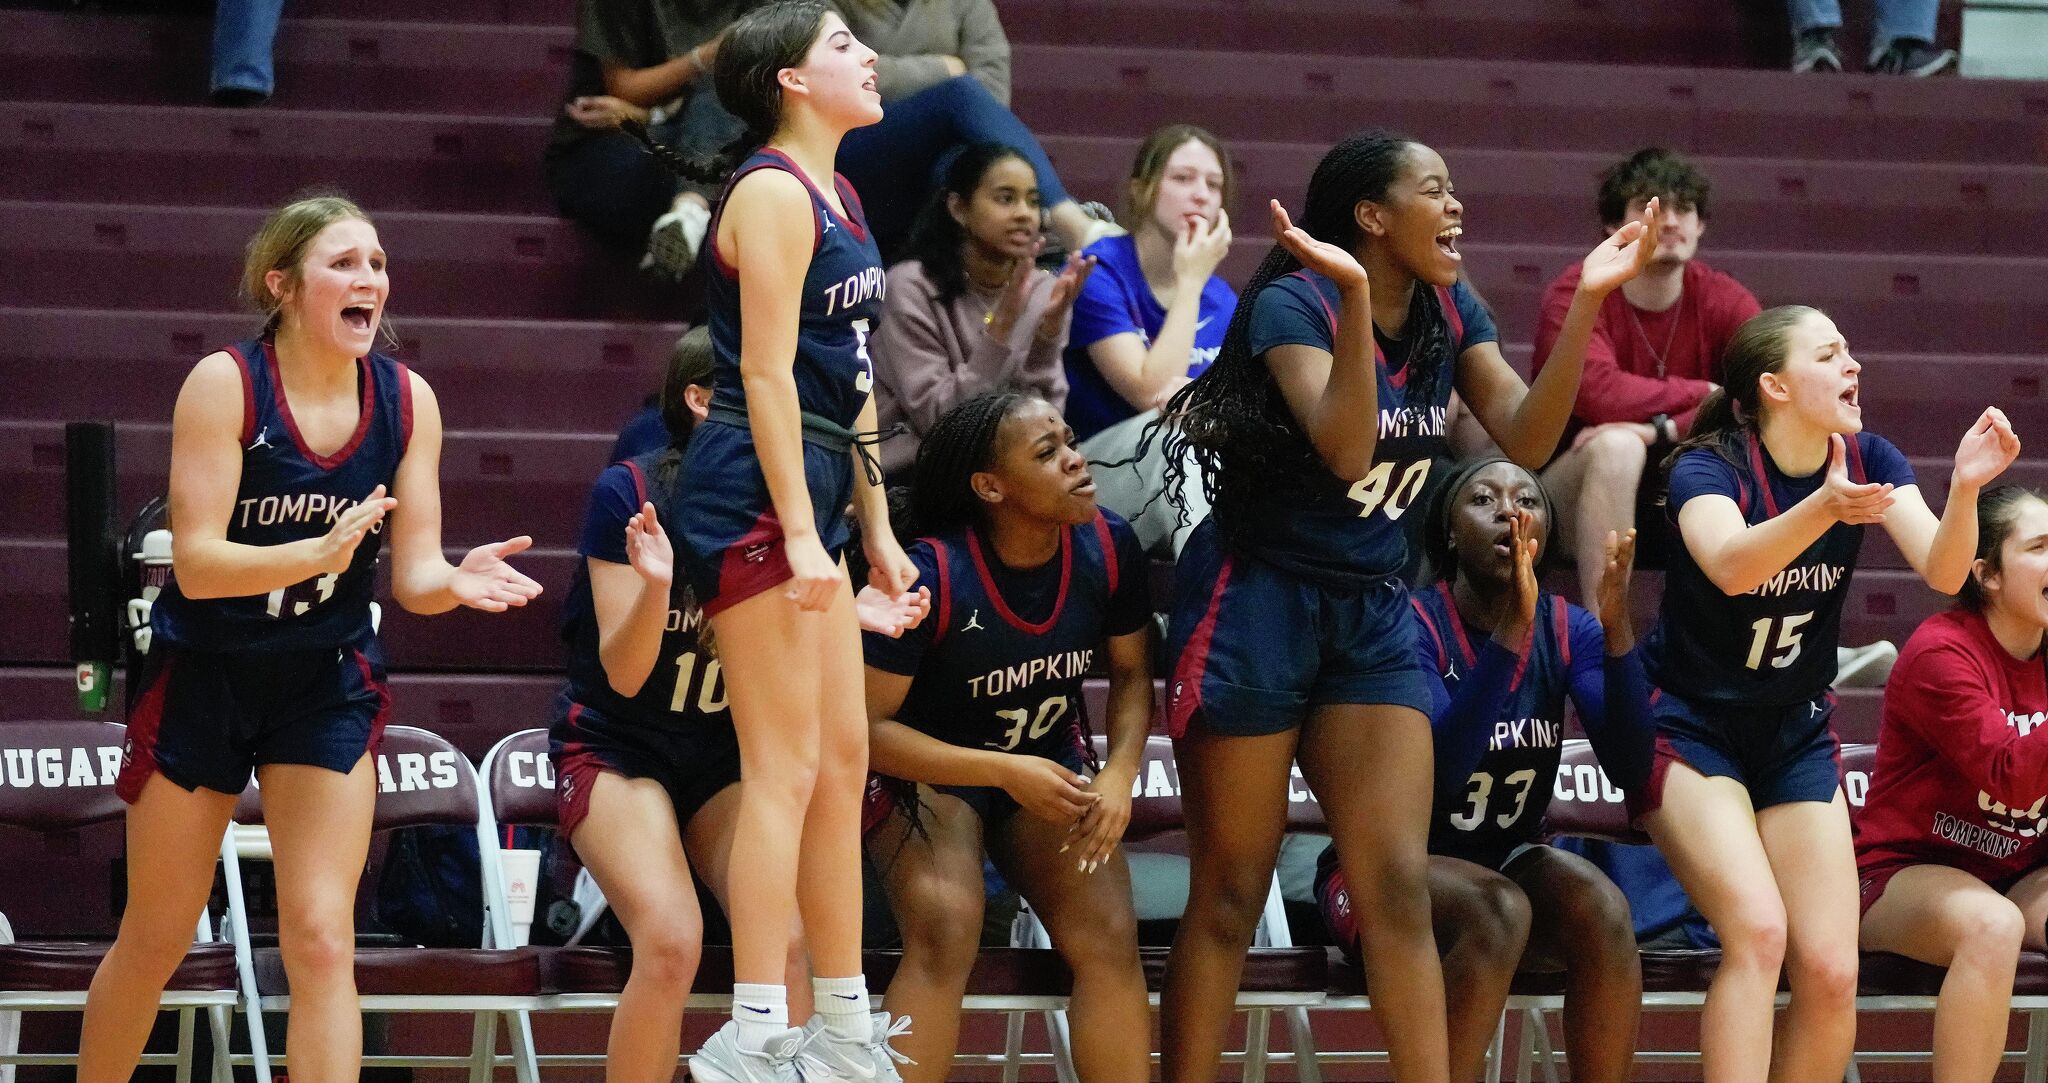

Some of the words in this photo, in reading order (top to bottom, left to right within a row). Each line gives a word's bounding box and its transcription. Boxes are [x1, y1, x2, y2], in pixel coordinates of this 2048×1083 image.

[851, 317, 874, 394] 5
[1346, 458, 1432, 521] 40
[1748, 562, 1845, 597] MPKINS
[1745, 610, 1815, 671] 15
[670, 652, 729, 714] 10
[968, 649, 1093, 698] TOMPKINS
[984, 695, 1068, 752] 30
[0, 746, 124, 788] UGAR
[1450, 768, 1537, 832] 33
[1932, 811, 2022, 860] TOMPKINS
